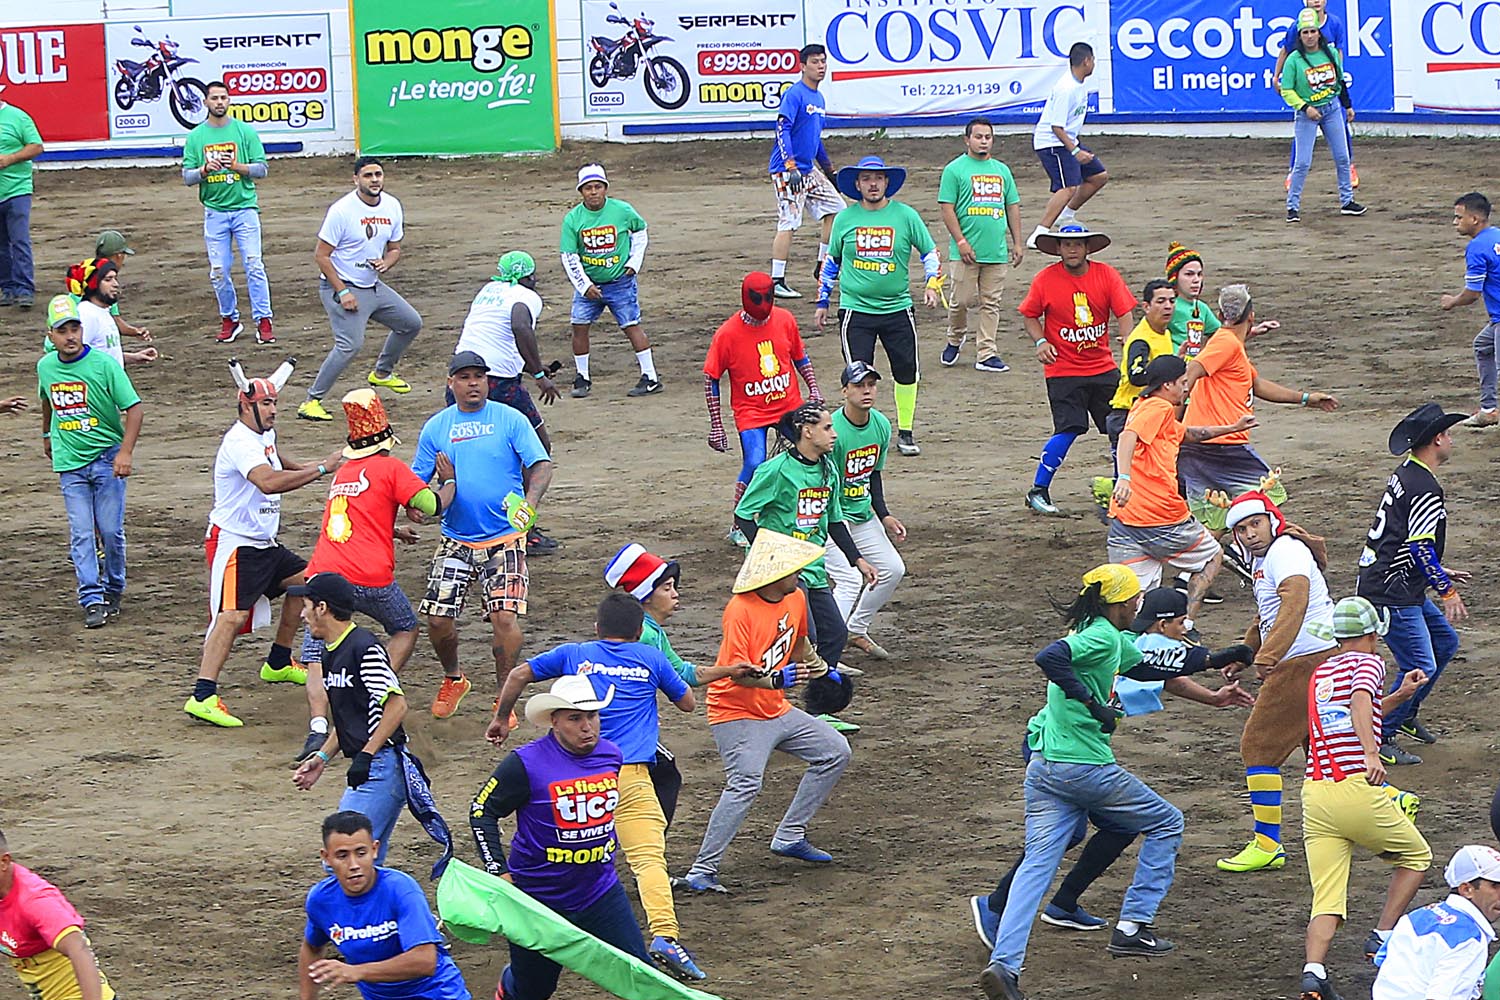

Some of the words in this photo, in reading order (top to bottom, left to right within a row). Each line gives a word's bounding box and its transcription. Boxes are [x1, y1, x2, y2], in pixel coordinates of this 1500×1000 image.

[826, 5, 1085, 64] COSVIC
[1117, 0, 1386, 59] ecotak
[365, 25, 532, 72] monge
[0, 30, 68, 88] UE
[389, 80, 426, 107] ¡Le
[428, 79, 494, 101] tengo
[497, 65, 536, 98] fe!
[1153, 67, 1174, 89] El
[1183, 66, 1256, 95] mejor
[901, 85, 926, 97] Tel:
[930, 83, 1000, 96] 2221-9139
[118, 118, 139, 126] 200
[225, 99, 325, 127] monge
[973, 182, 1001, 196] tica
[967, 206, 1004, 220] monge
[583, 234, 615, 248] tica
[857, 235, 891, 249] tica
[581, 254, 620, 267] monge
[853, 259, 896, 275] monge
[745, 373, 791, 396] CACIQU
[51, 391, 85, 406] tica
[449, 423, 495, 439] COSVIC
[846, 457, 876, 475] tica
[762, 625, 794, 674] JET
[593, 663, 650, 678] Protecto
[555, 785, 575, 796] La
[575, 778, 618, 794] fiesta
[555, 790, 619, 823] tica
[562, 830, 579, 839] SE
[580, 825, 603, 838] VIVE
[345, 920, 398, 939] Protecto
